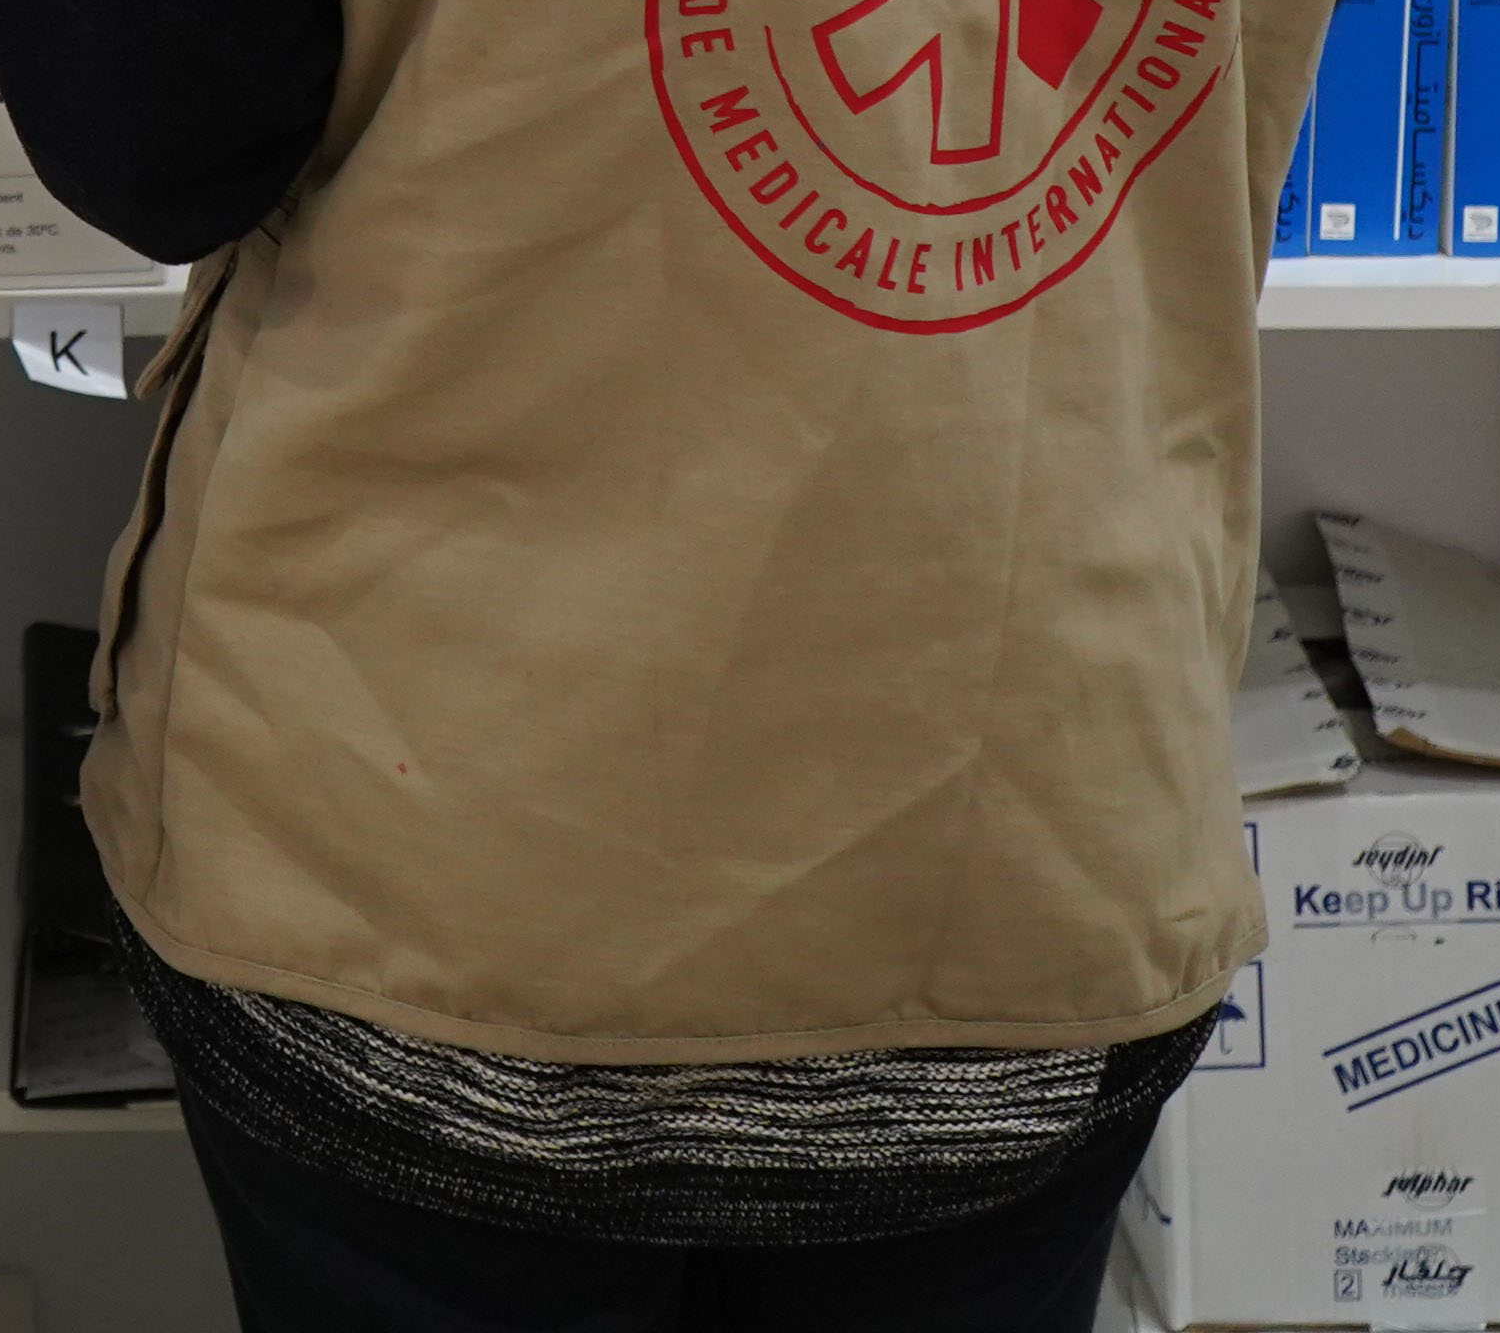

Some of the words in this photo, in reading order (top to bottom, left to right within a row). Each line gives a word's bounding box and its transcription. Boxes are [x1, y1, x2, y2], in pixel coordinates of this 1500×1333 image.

[700, 84, 933, 295] MEDICALE
[50, 329, 89, 377] K
[1293, 881, 1390, 921] Keep
[1401, 883, 1454, 921] Up
[1340, 1272, 1357, 1296] 2
